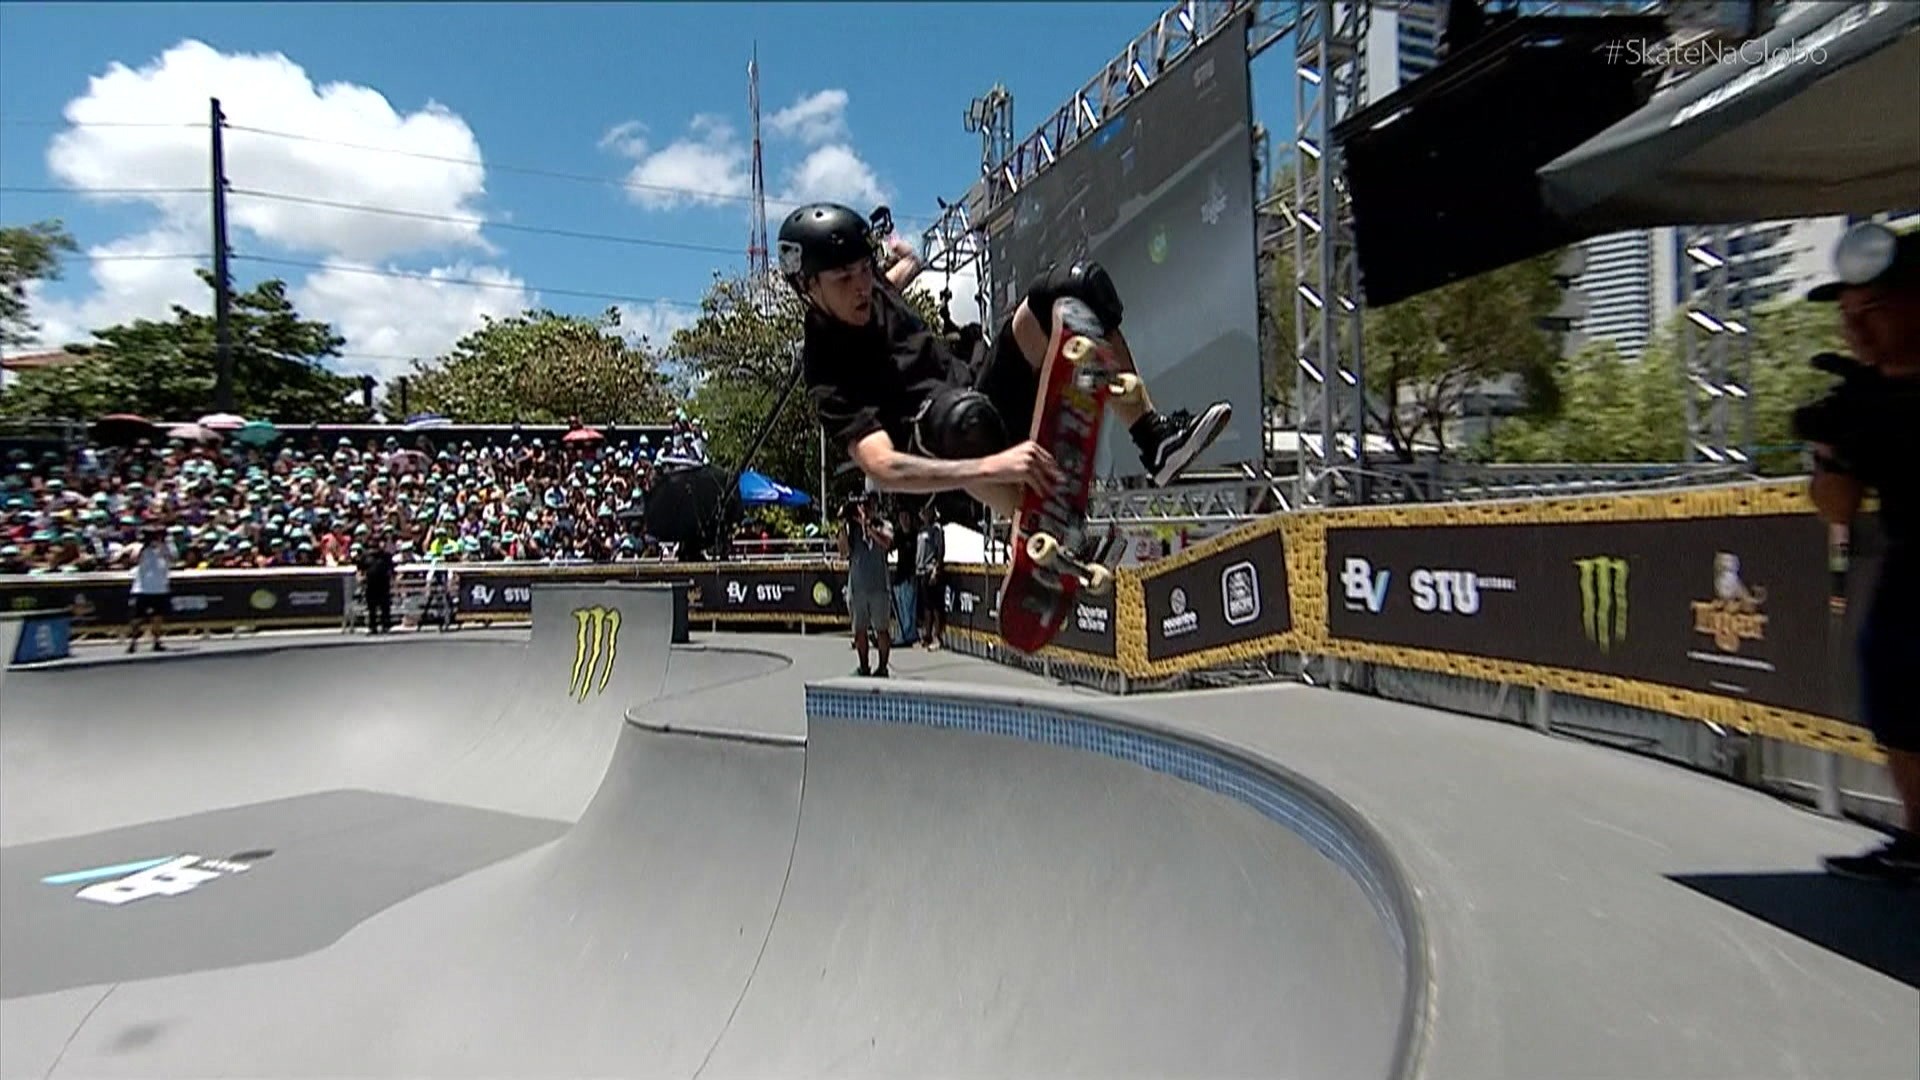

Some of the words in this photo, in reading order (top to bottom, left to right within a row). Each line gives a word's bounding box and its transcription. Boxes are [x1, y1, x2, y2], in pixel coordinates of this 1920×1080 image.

[504, 587, 530, 602] STU
[756, 584, 781, 600] STU
[1410, 569, 1480, 614] STU
